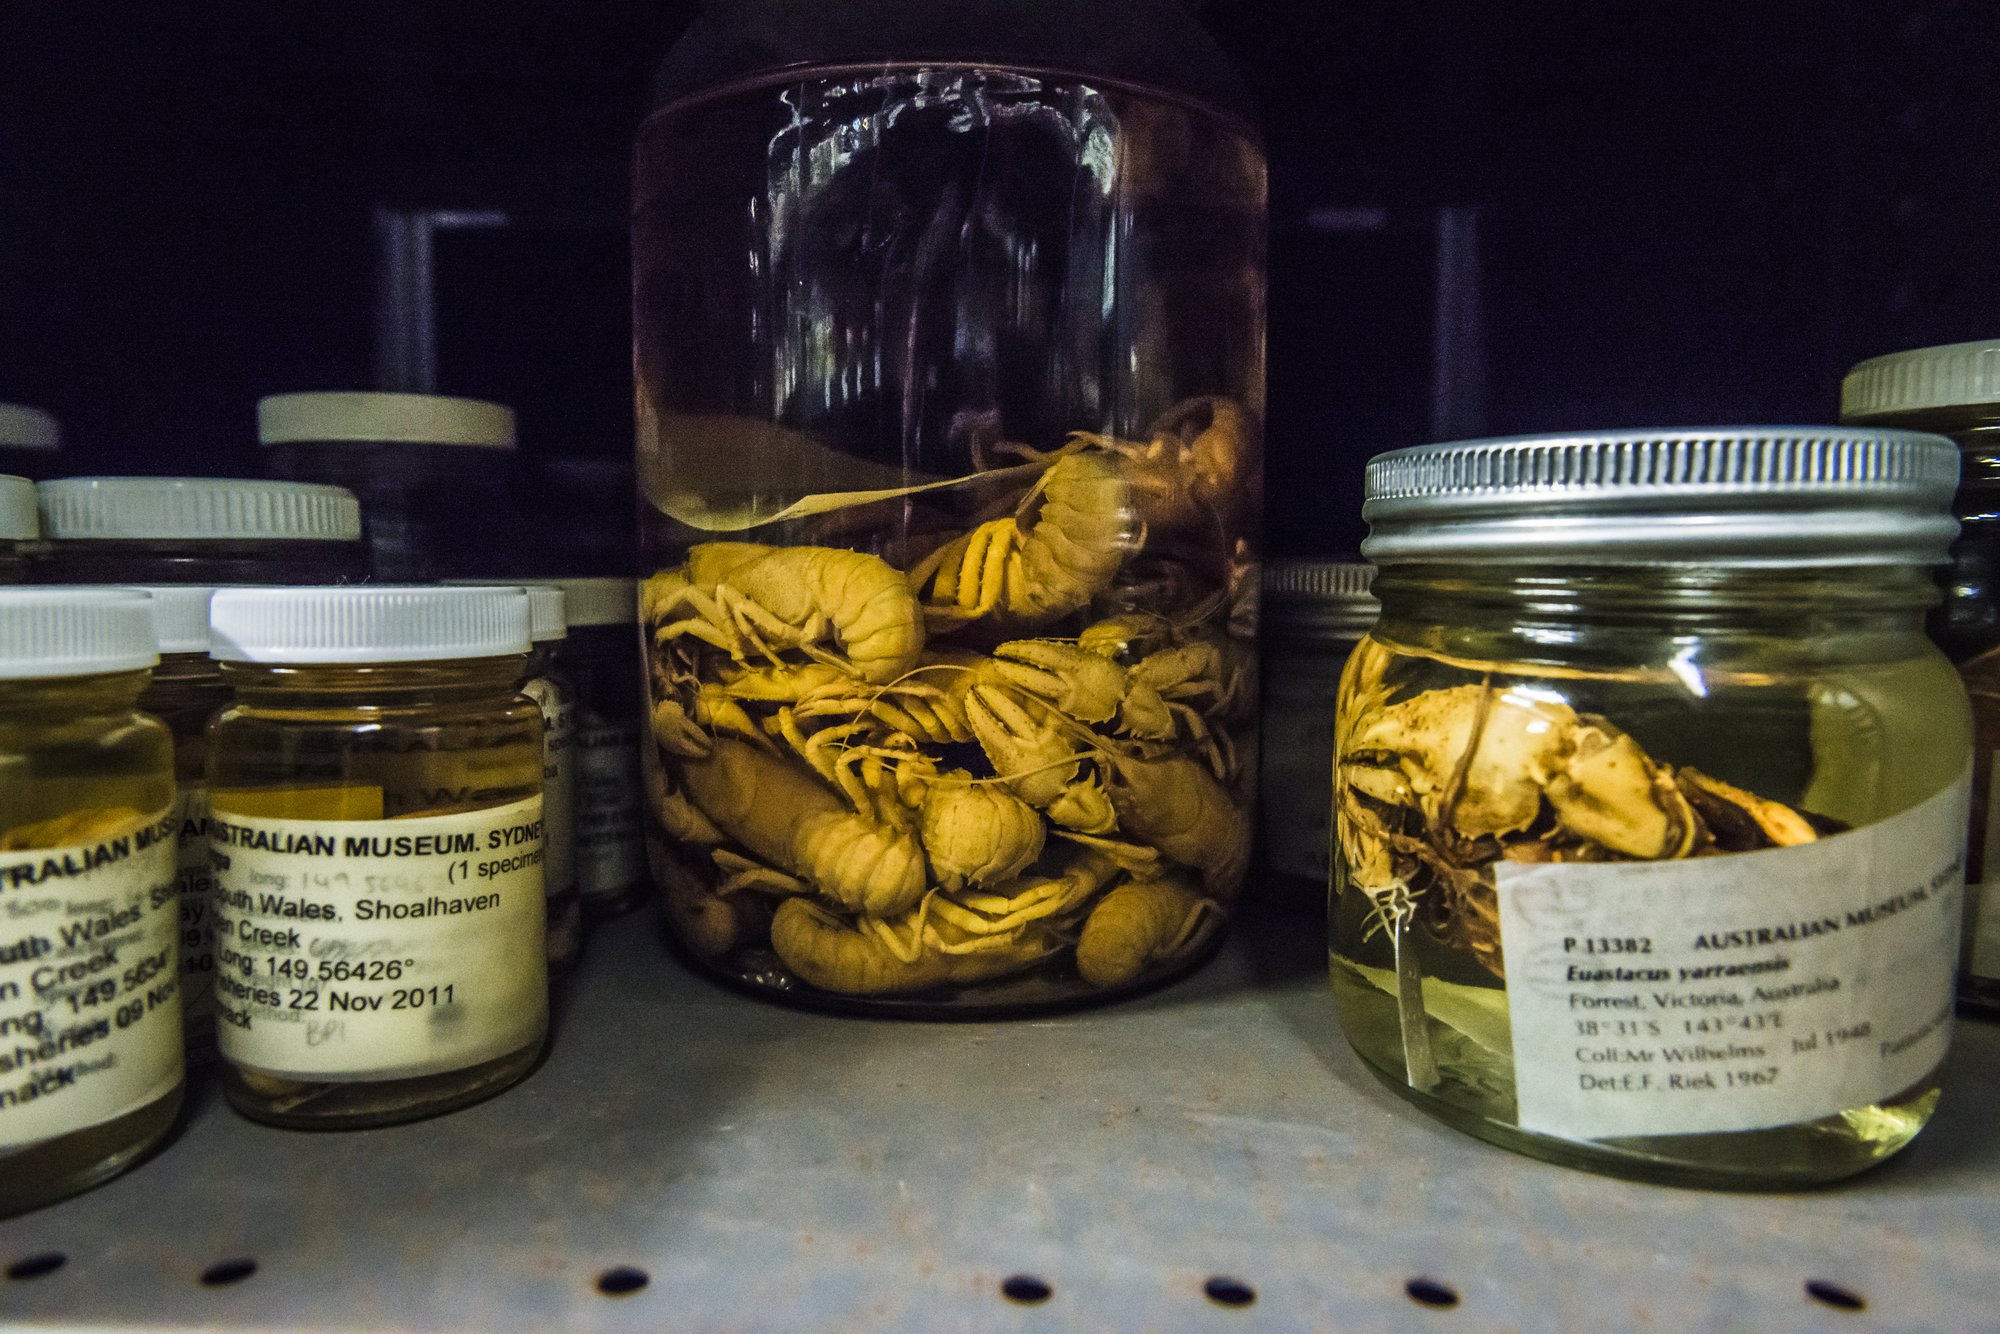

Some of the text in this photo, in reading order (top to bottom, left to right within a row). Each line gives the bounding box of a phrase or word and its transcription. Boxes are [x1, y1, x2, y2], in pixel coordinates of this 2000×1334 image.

[355, 892, 501, 921] Shoalhaven
[58, 904, 143, 948] Wales
[239, 920, 301, 949] Creek
[1694, 916, 1842, 950] AUSTRALIAN
[30, 952, 119, 996] Creek
[115, 997, 145, 1029] 09
[288, 988, 319, 1011] 22
[329, 990, 383, 1012] Nov
[391, 983, 455, 1010] 2011
